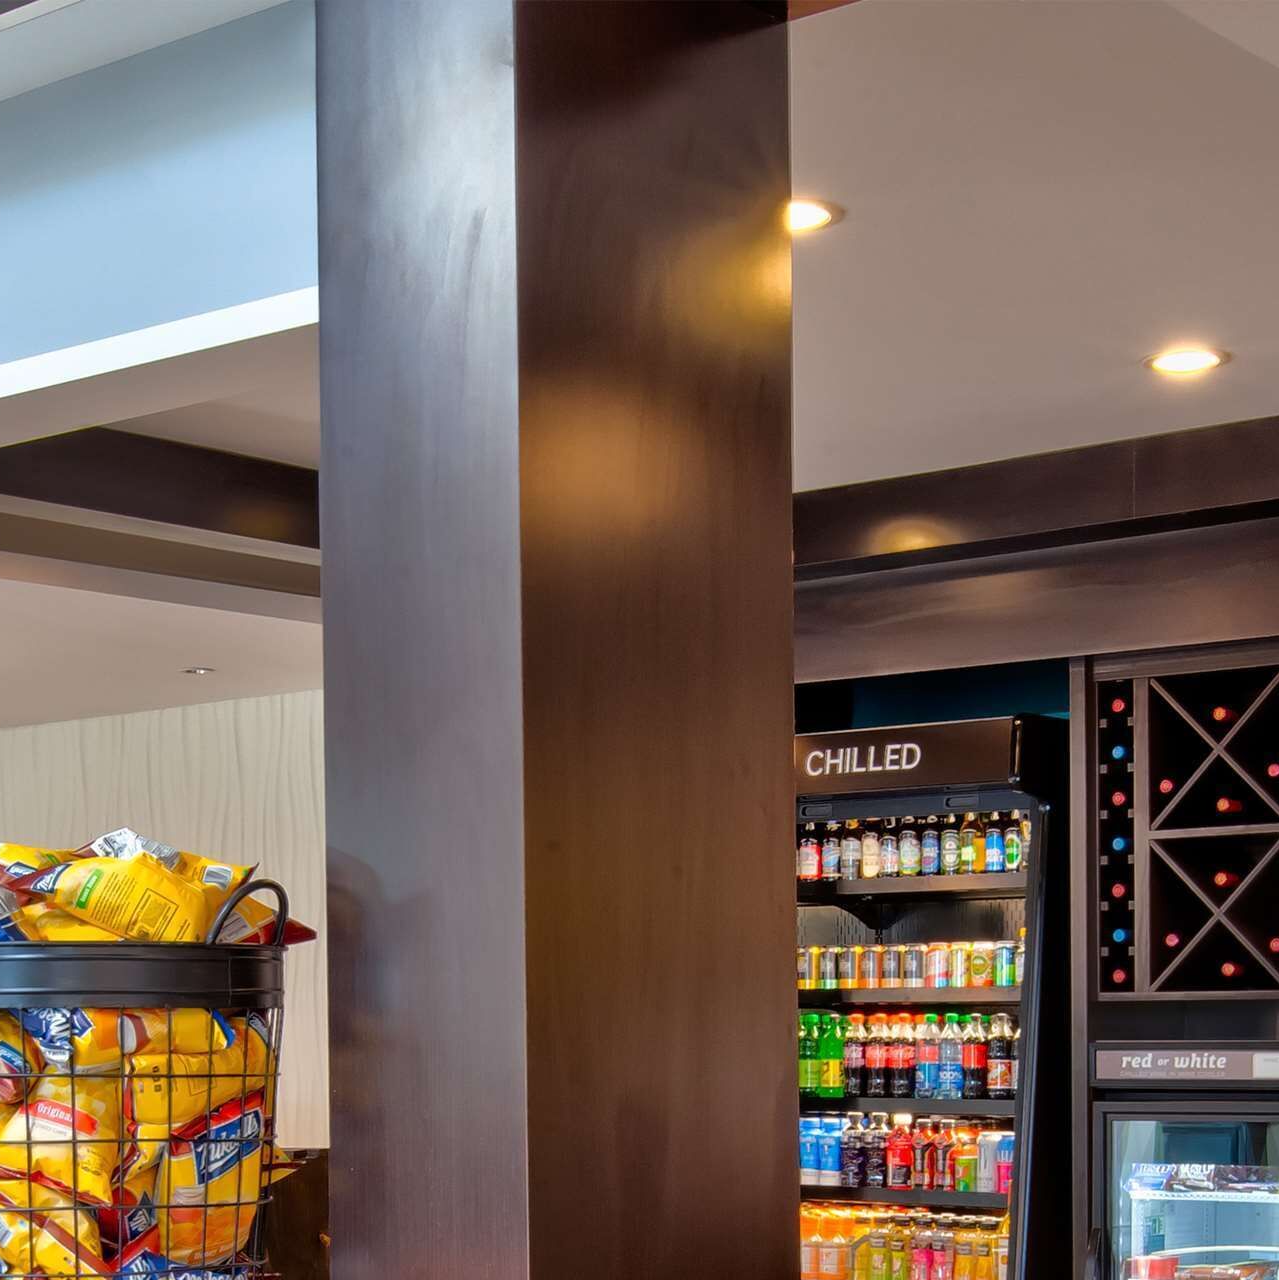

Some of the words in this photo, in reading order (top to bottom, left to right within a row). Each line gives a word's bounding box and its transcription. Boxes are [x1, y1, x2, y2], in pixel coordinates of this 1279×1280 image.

[805, 743, 922, 777] CHILLED
[1121, 1053, 1153, 1069] red
[1157, 1056, 1170, 1067] or
[1173, 1052, 1227, 1069] white
[37, 1102, 75, 1122] Origina
